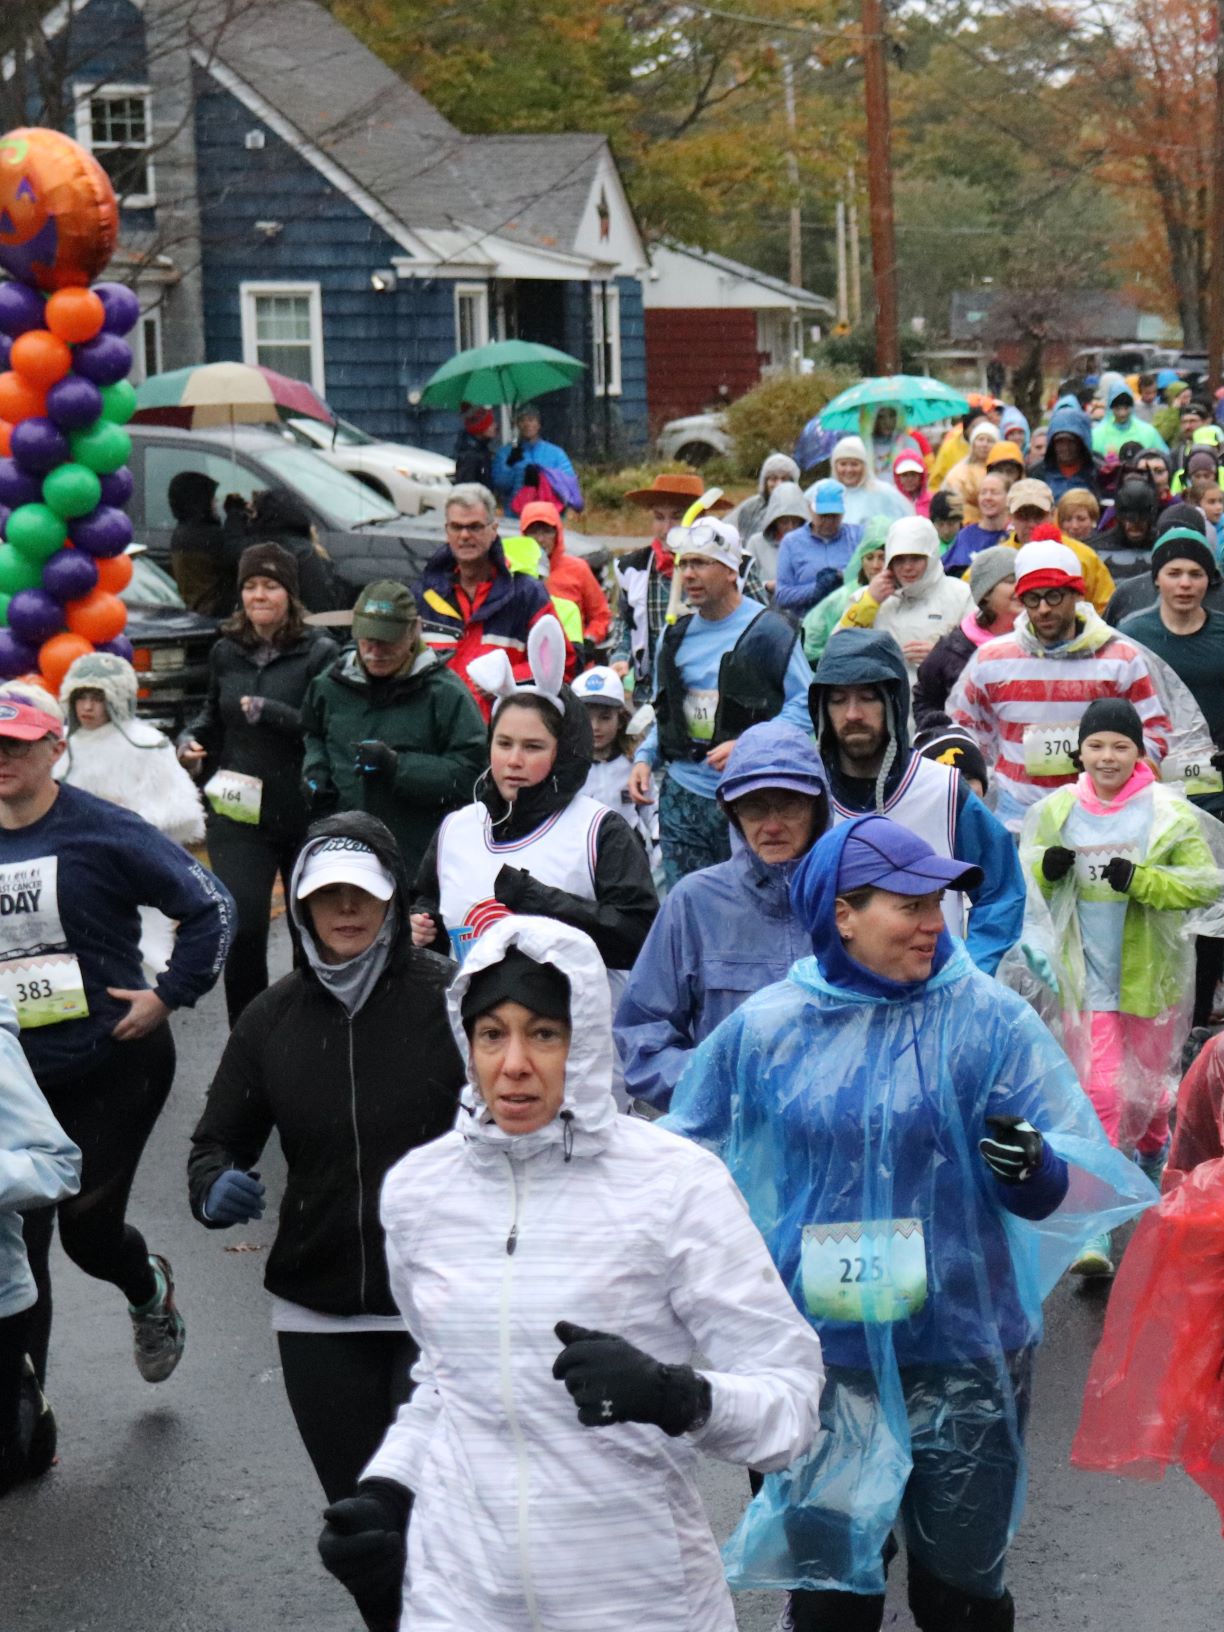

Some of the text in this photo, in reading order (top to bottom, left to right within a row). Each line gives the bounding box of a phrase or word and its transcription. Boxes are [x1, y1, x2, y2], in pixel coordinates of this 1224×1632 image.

[1044, 739, 1071, 756] 370
[1185, 764, 1200, 777] 60
[222, 788, 241, 803] 164
[0, 888, 41, 915] DAY
[16, 979, 53, 1002] 383
